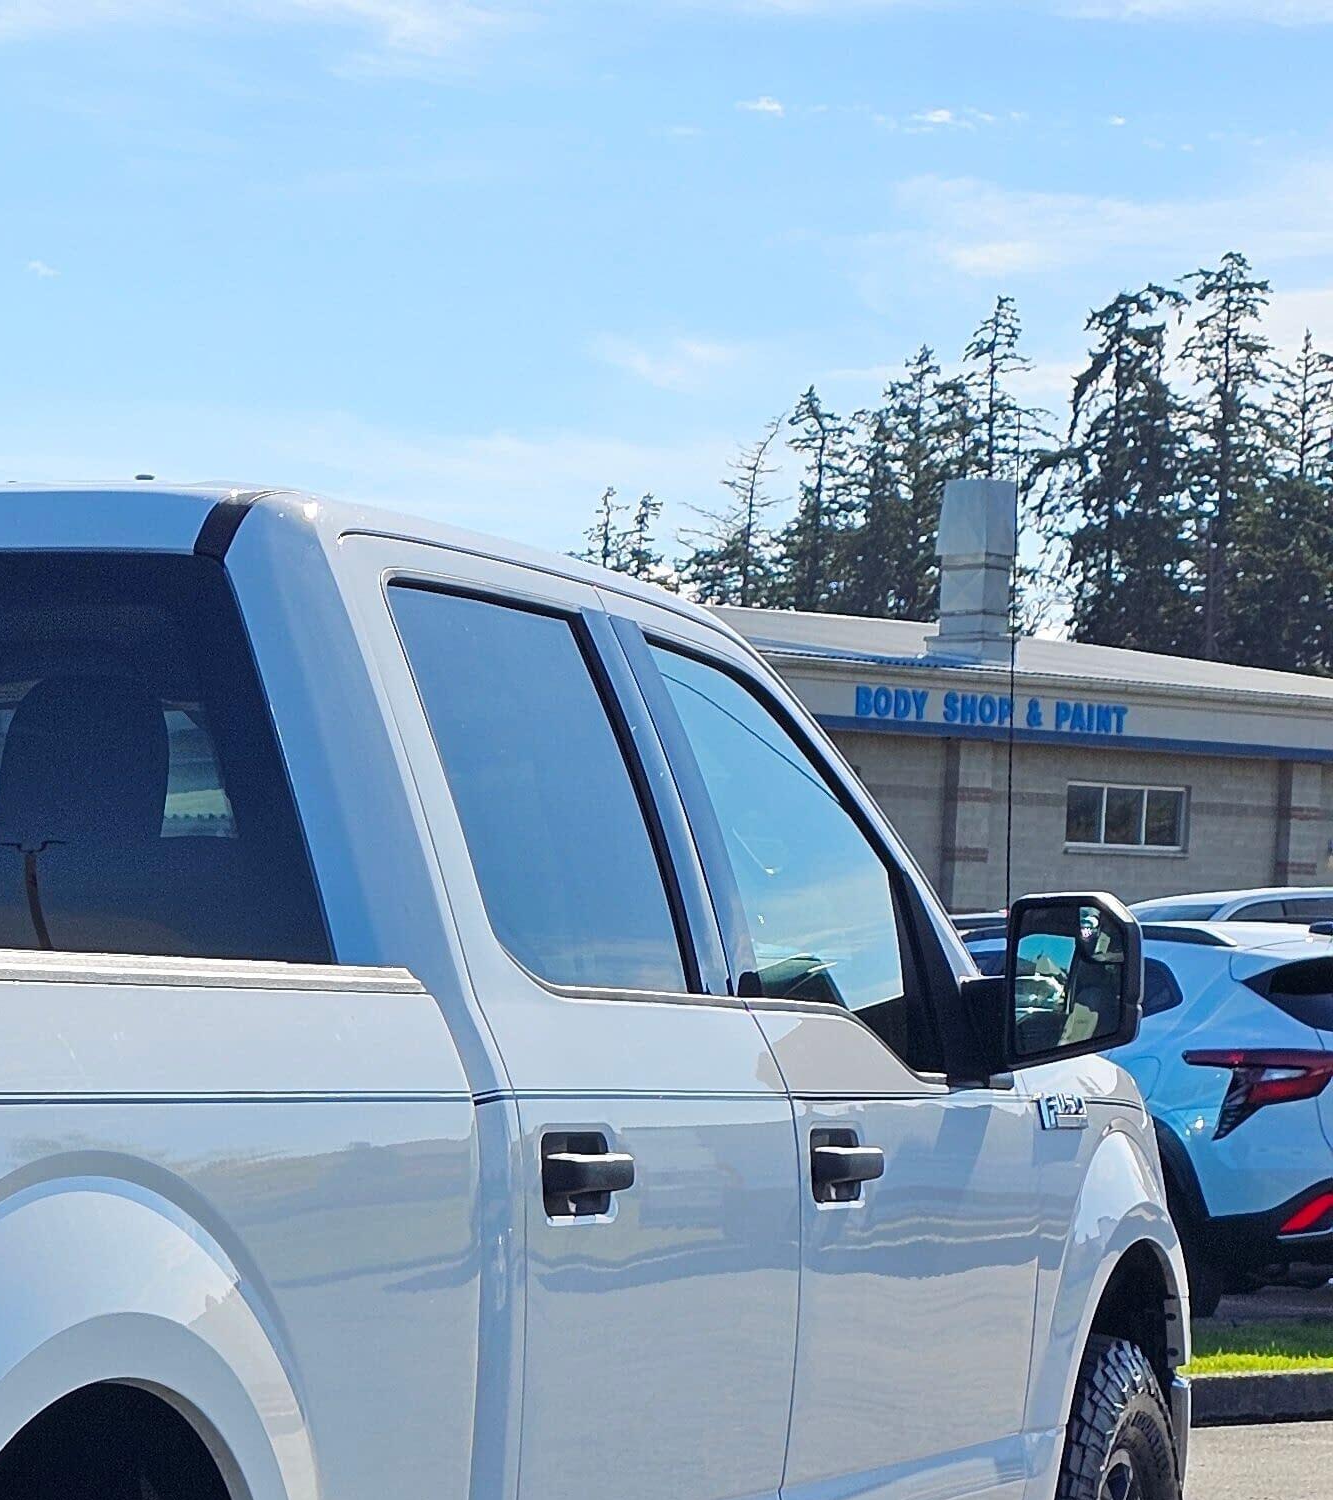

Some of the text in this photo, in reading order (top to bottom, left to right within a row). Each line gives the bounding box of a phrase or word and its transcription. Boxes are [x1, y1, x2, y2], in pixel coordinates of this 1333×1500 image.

[855, 684, 1129, 735] BODY SHOP & PAINT
